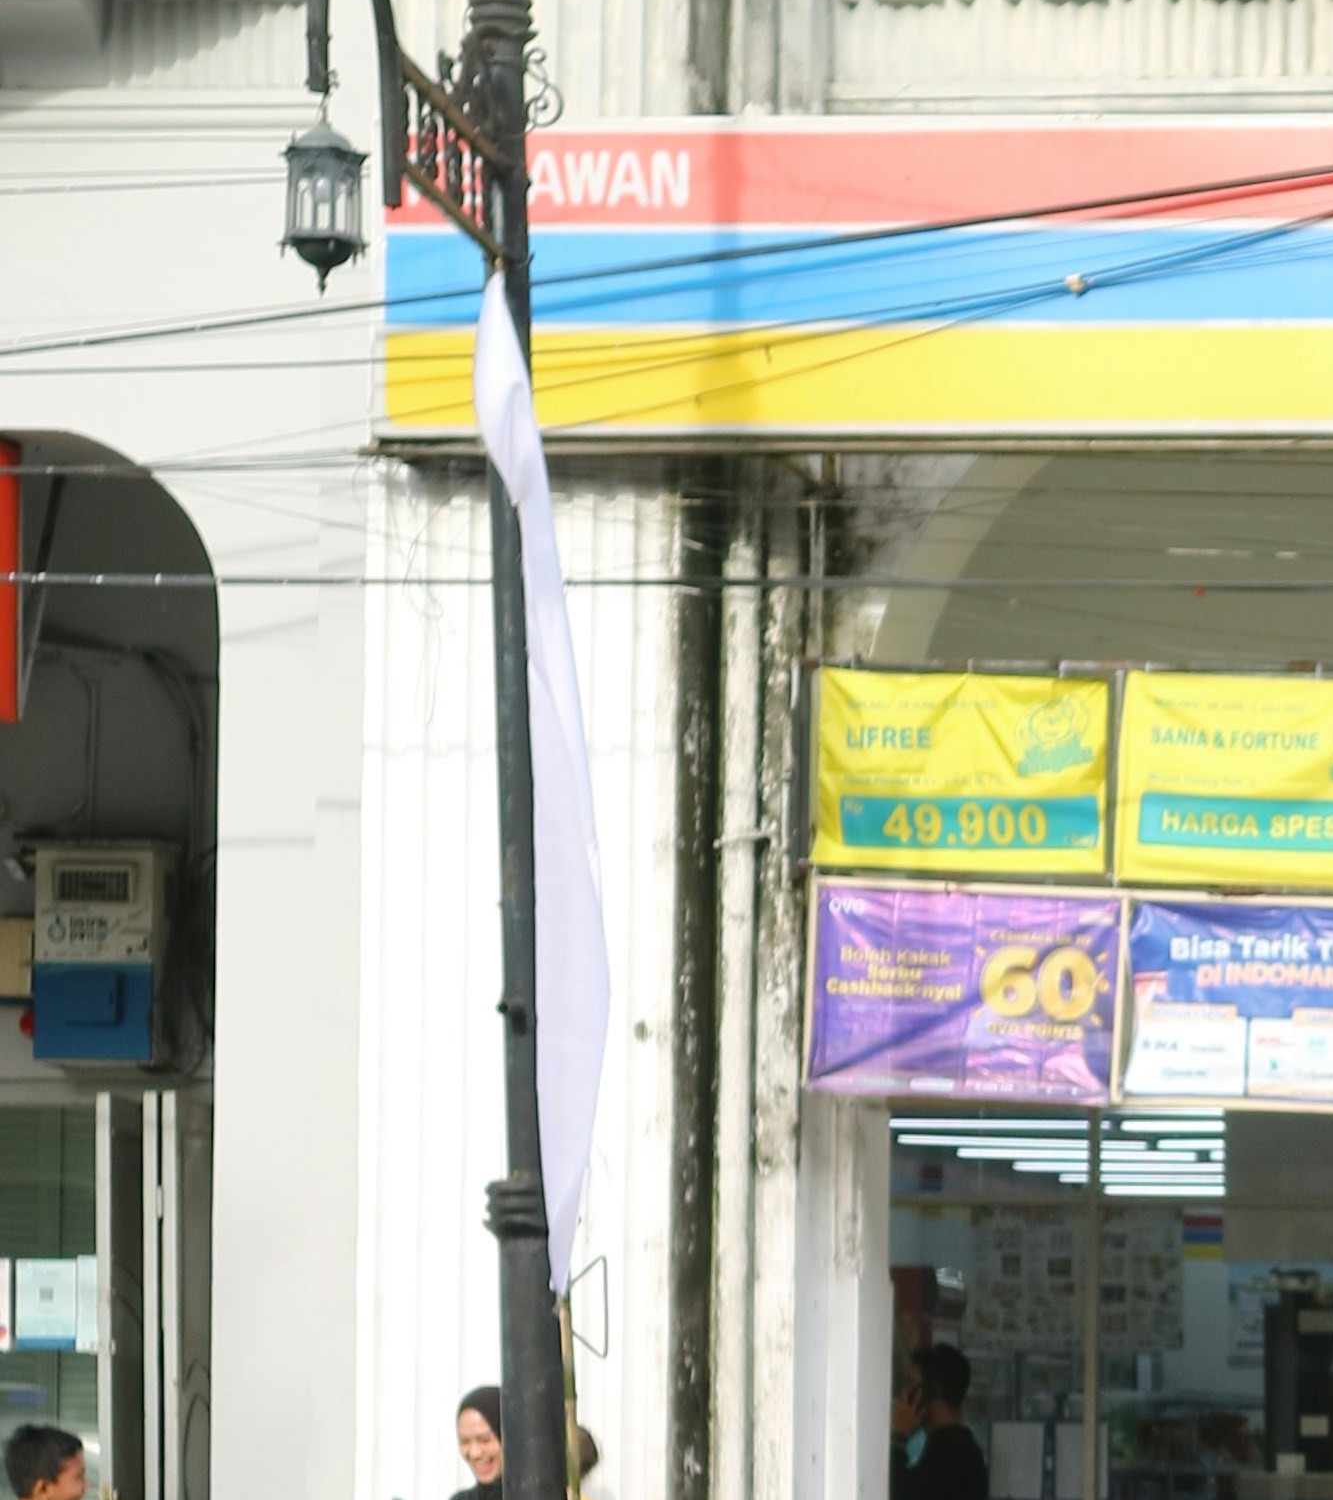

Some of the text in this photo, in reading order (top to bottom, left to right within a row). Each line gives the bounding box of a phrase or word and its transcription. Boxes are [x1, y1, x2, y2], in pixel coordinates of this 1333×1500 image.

[846, 726, 932, 750] LIFREE
[1151, 726, 1319, 751] SANIA & FORTUNE
[882, 802, 1047, 846] 49.900
[1161, 808, 1259, 838] HARGA
[840, 945, 951, 967] Boleh Kakak
[1169, 934, 1231, 961] Bisa
[1237, 933, 1310, 960] Tarik
